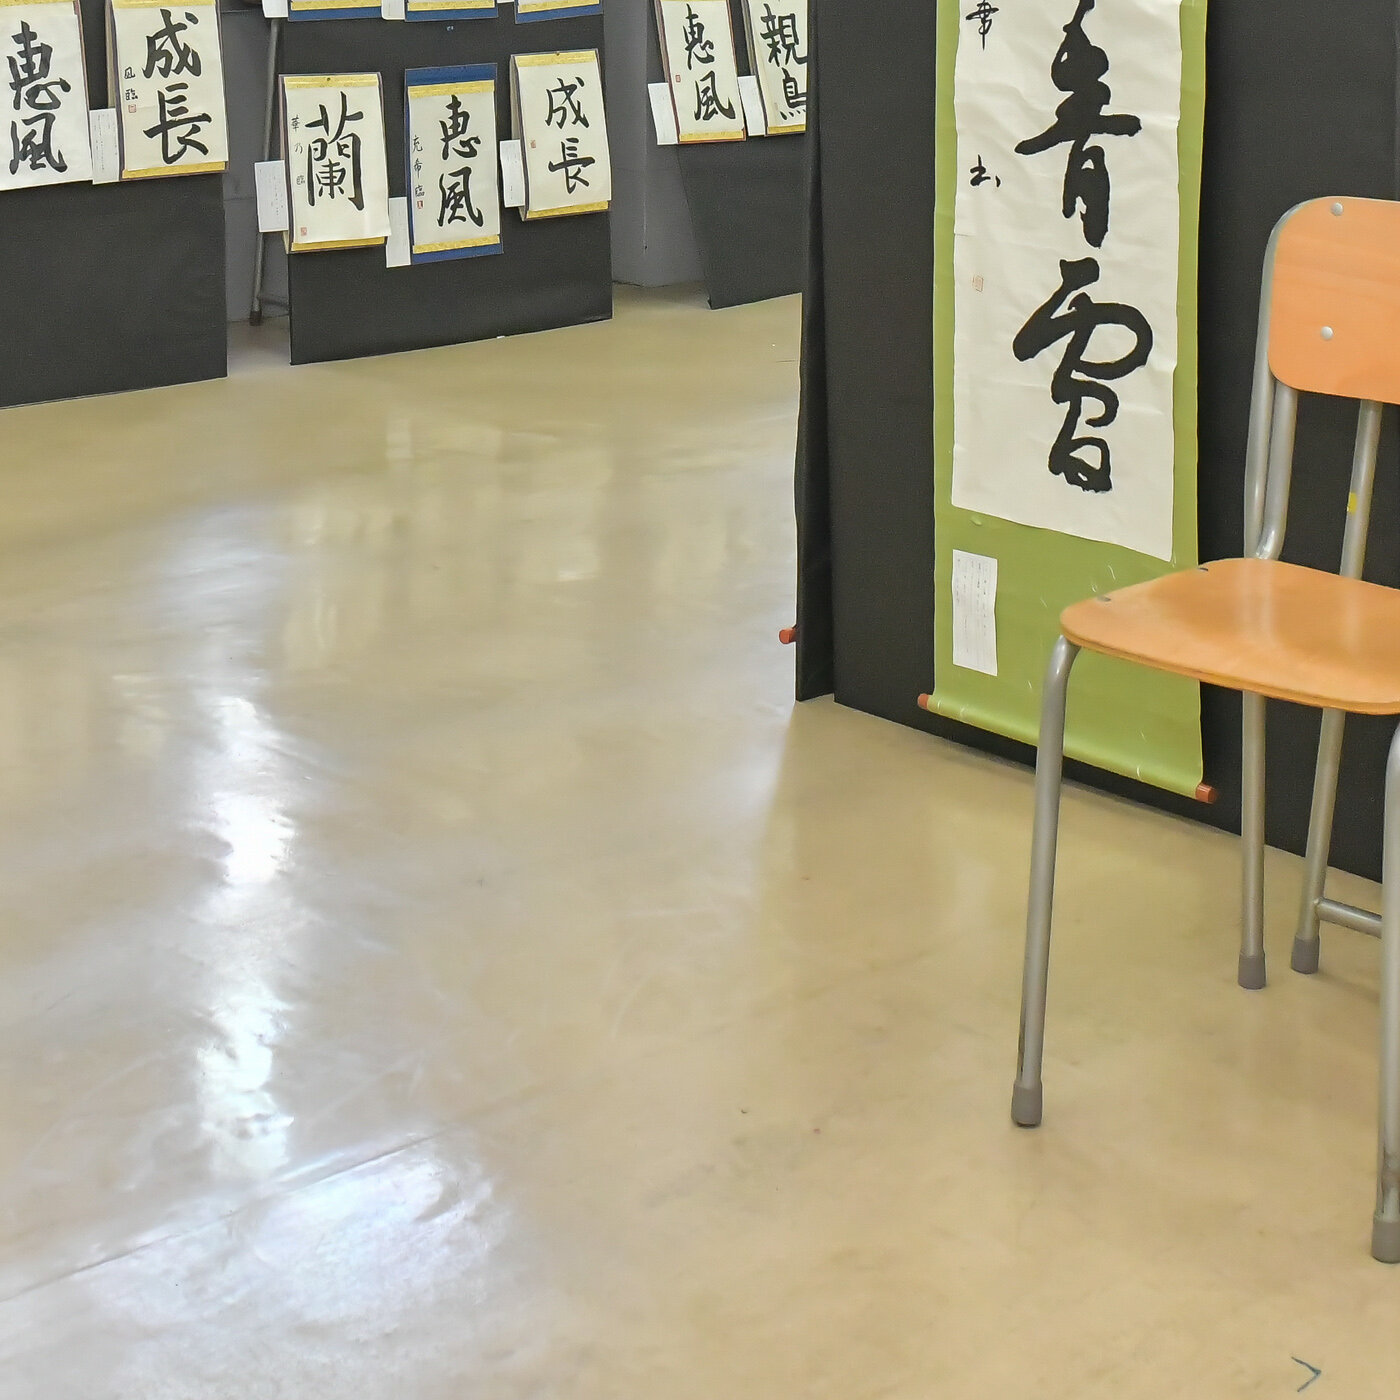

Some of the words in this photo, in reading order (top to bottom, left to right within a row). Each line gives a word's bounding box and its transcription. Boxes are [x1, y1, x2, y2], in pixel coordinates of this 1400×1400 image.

[142, 8, 212, 165] 成長
[544, 76, 596, 194] 成長
[304, 90, 365, 211] 蘭
